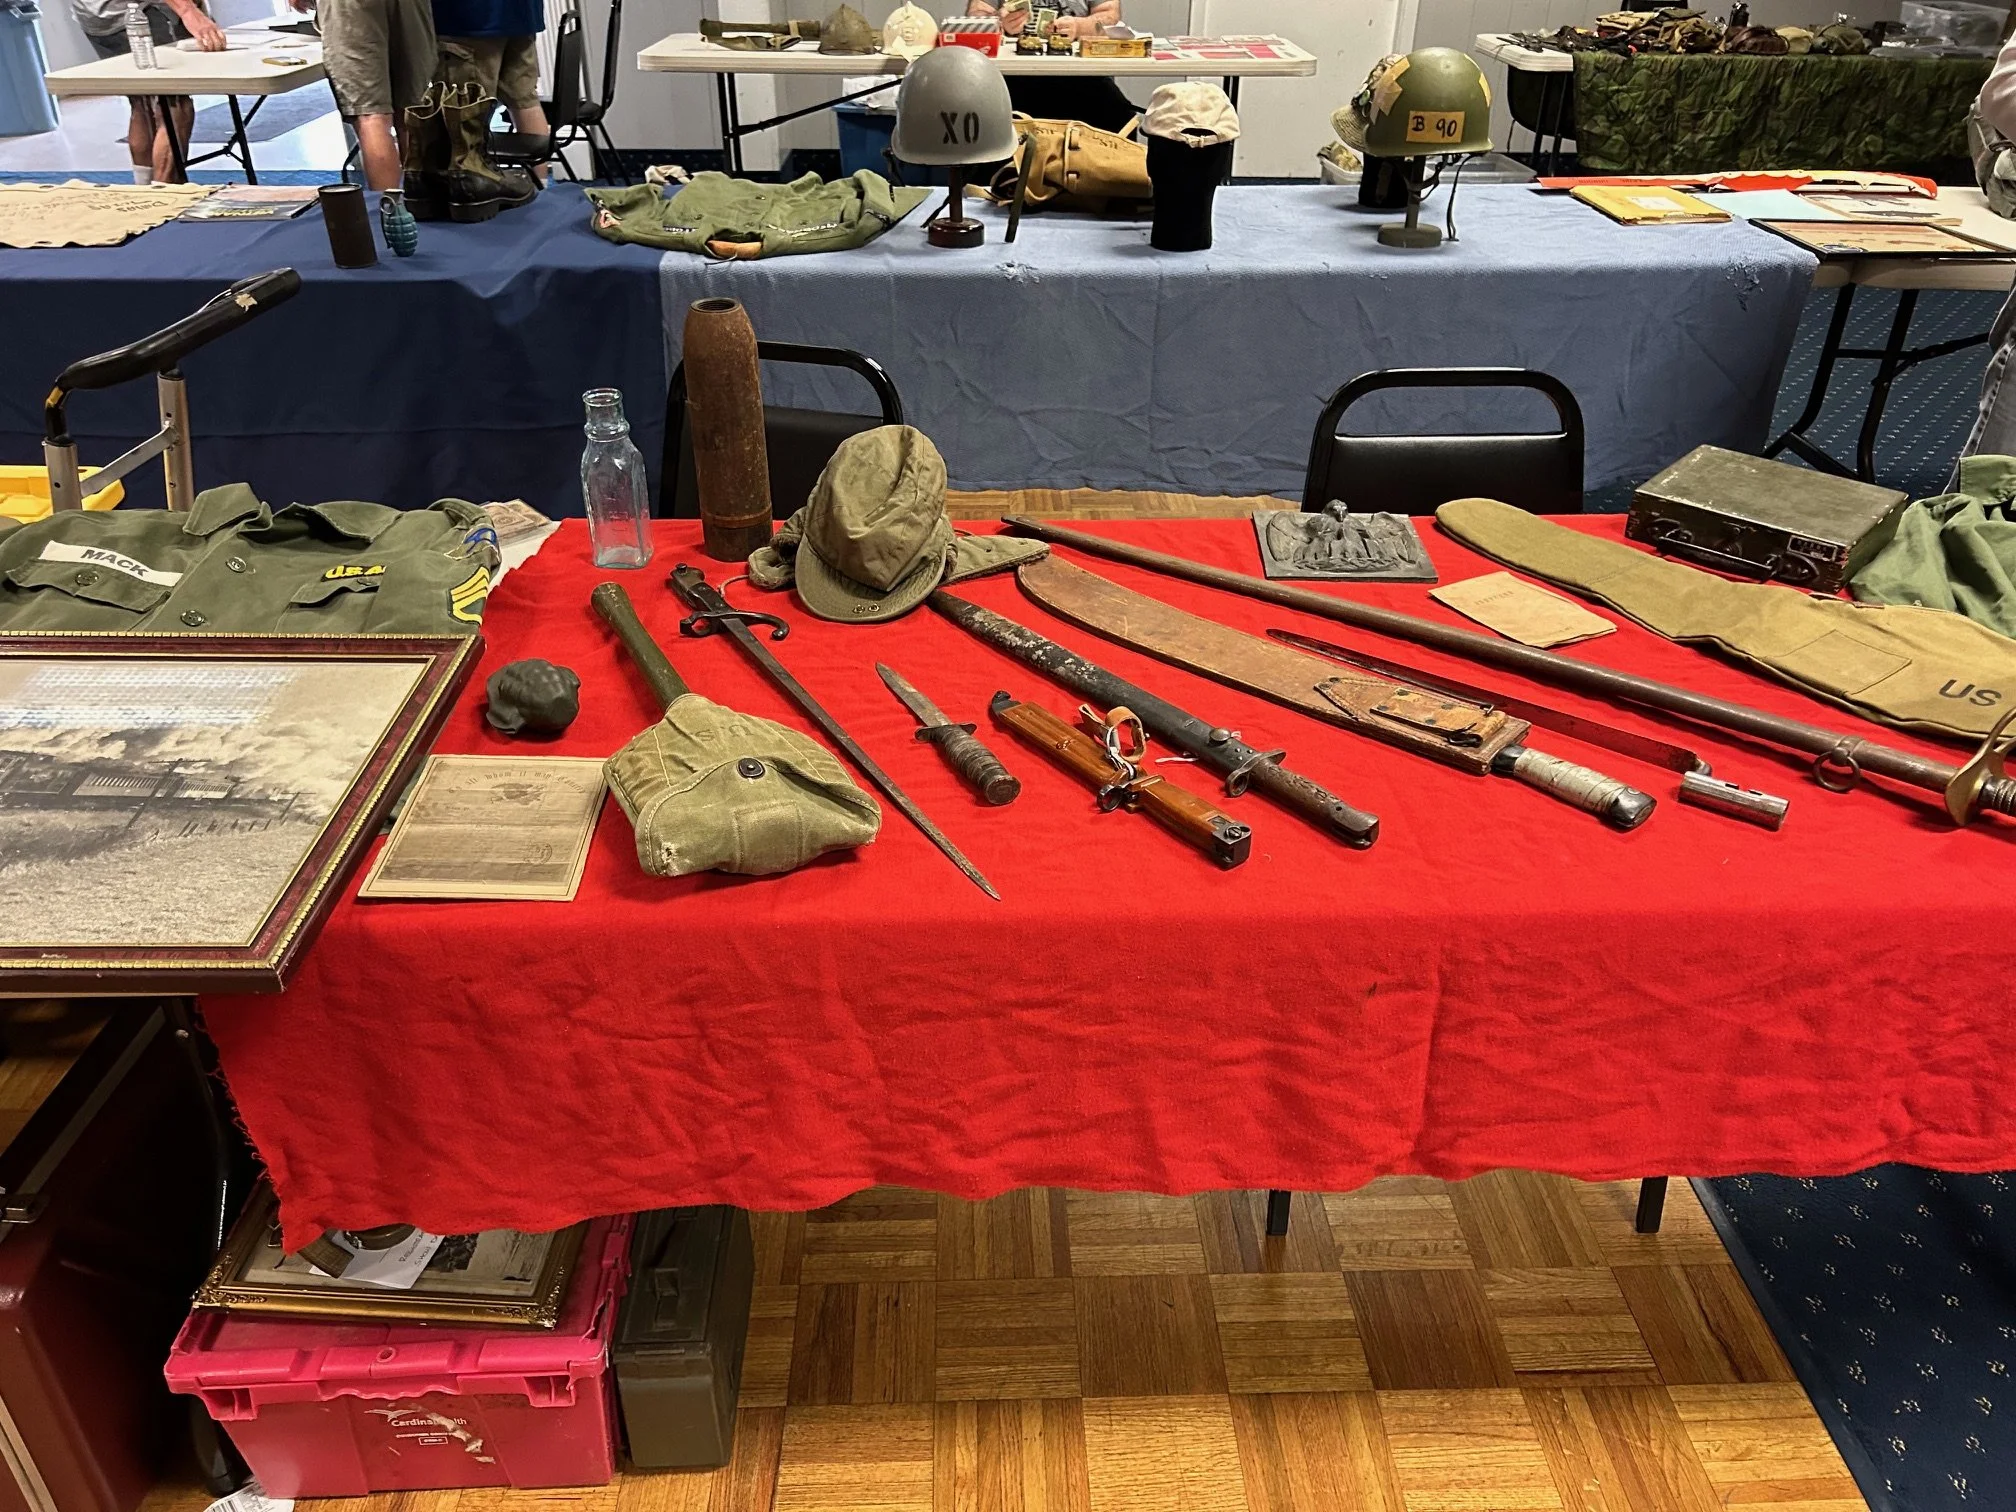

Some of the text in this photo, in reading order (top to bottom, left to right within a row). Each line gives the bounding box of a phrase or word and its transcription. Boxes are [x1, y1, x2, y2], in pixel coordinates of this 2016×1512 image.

[940, 111, 979, 144] XO
[1412, 116, 1457, 138] B 90
[80, 549, 149, 577] MACK
[1939, 679, 2002, 707] US
[391, 1418, 438, 1427] Cardina
